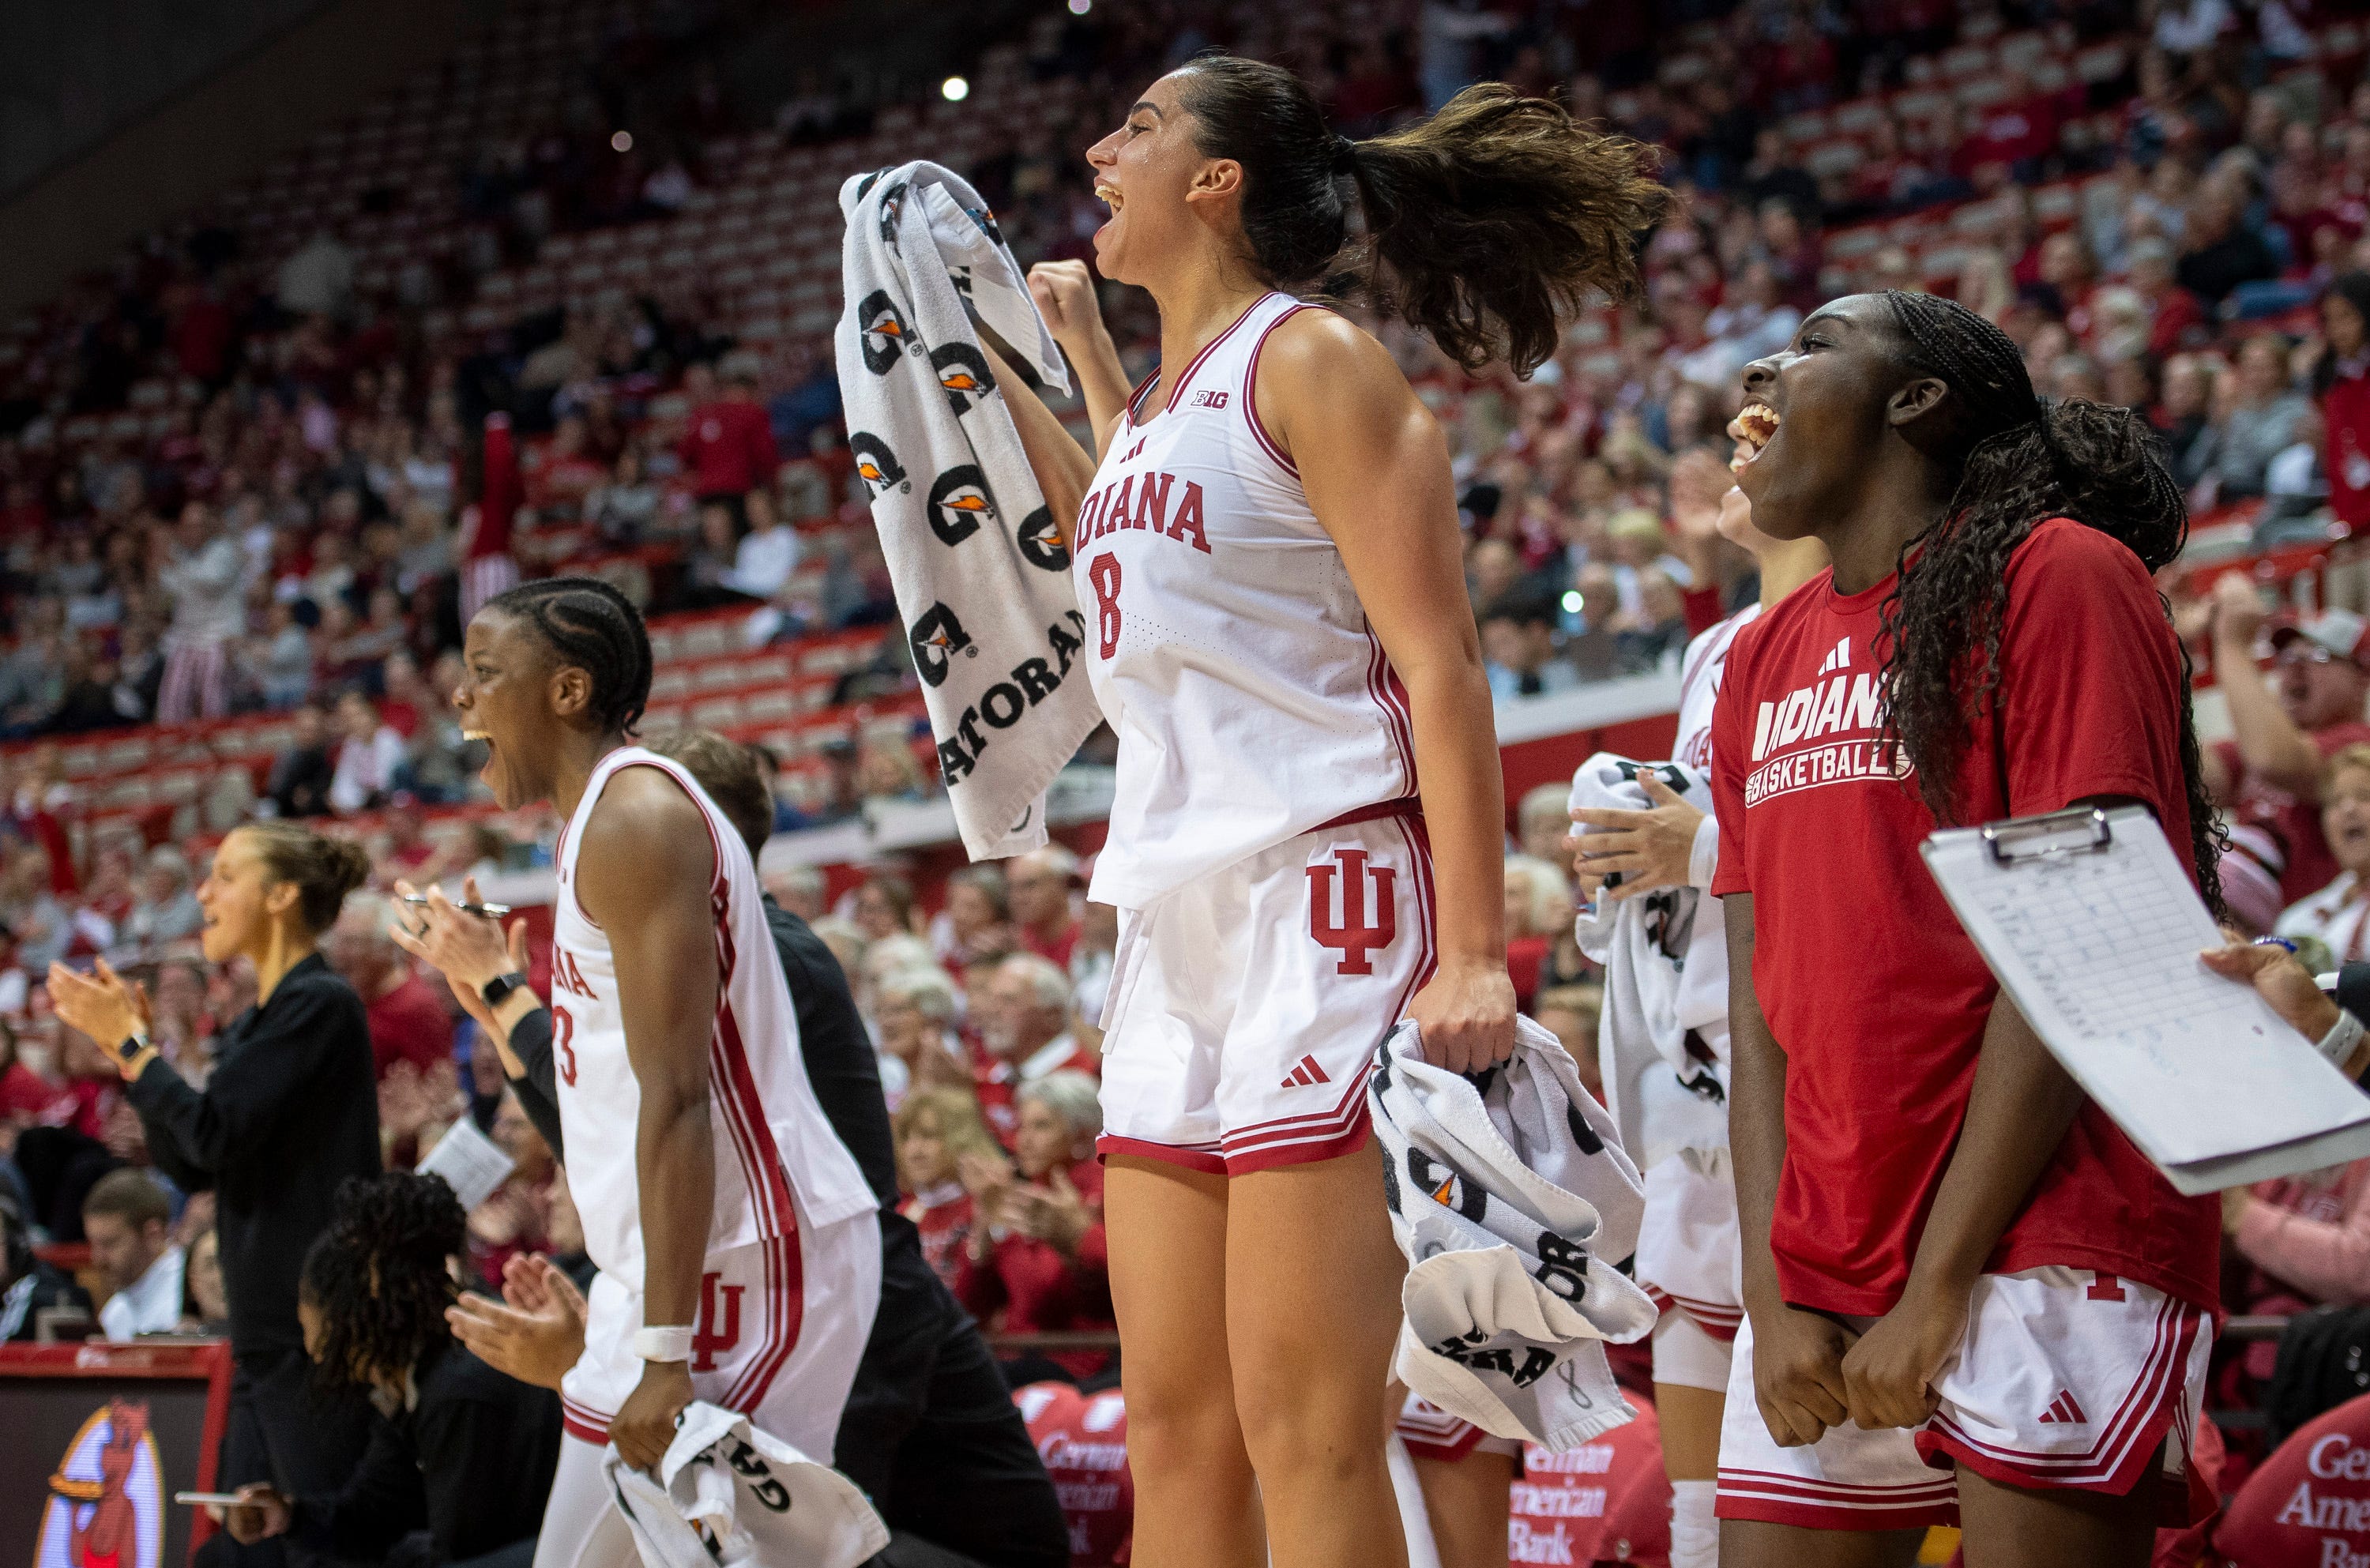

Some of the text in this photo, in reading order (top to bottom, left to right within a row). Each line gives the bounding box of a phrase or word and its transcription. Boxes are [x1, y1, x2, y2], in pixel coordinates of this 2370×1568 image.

[1074, 472, 1212, 555] DIANA
[1089, 551, 1122, 660] 8
[1751, 672, 1902, 761] INDIAN
[1750, 743, 1889, 803] BASKETBALL
[1306, 849, 1397, 975] IU
[1510, 1476, 1606, 1517] merican
